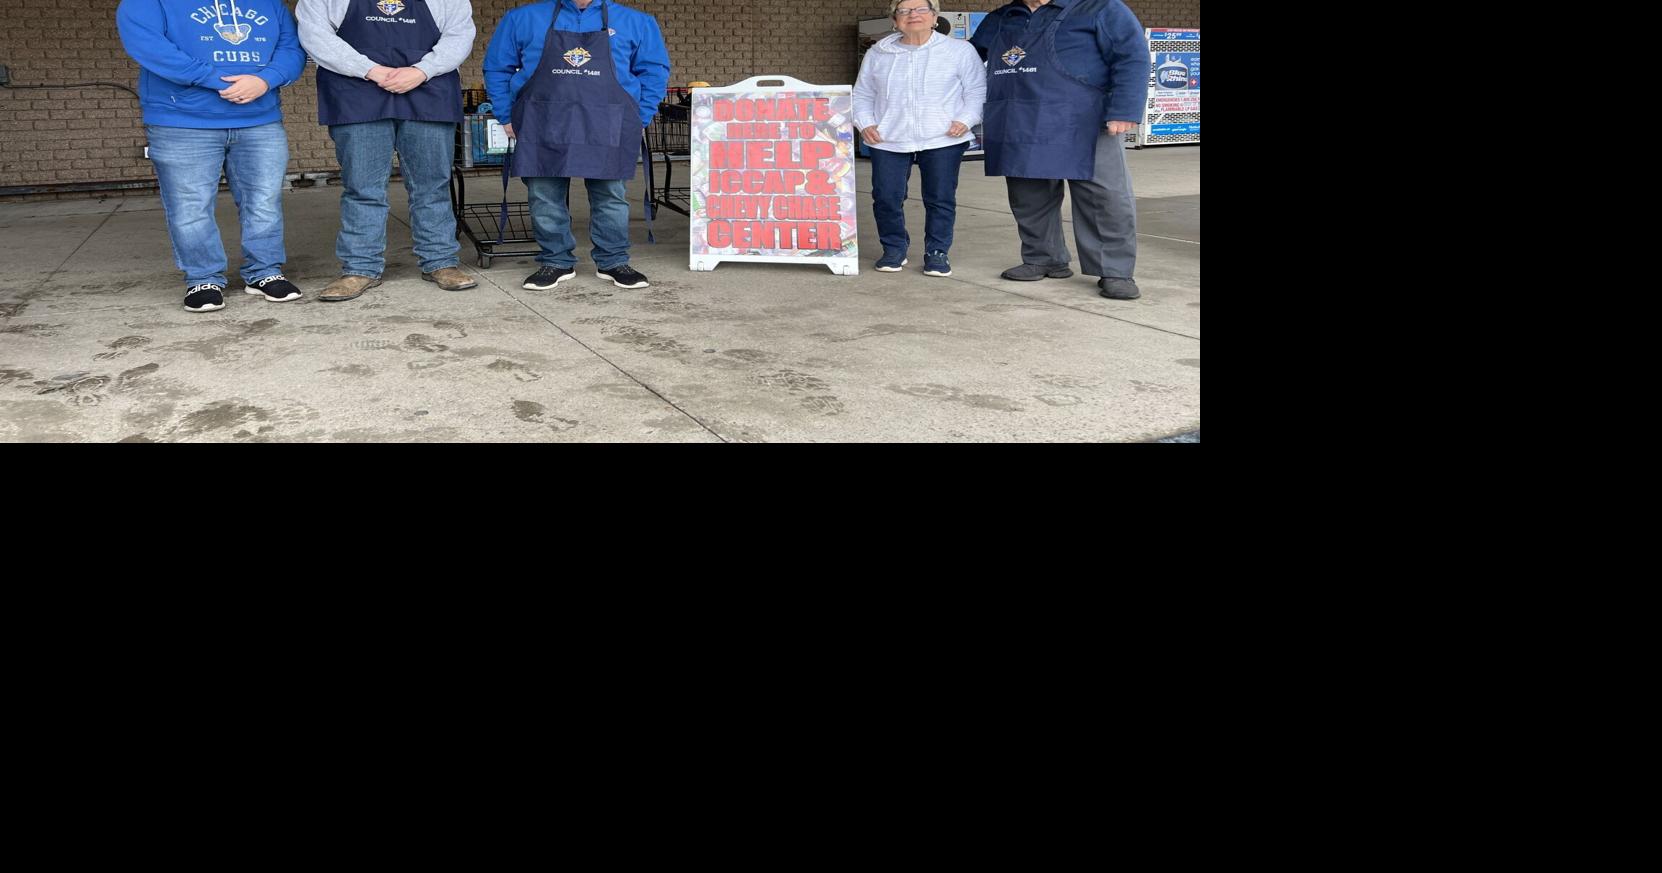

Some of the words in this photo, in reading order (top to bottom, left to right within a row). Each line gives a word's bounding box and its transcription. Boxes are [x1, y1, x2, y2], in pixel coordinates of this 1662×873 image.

[190, 3, 269, 26] CHICAGO
[213, 50, 260, 62] CUBS
[712, 97, 831, 122] DONATE
[726, 122, 782, 139] HERE
[786, 122, 816, 139] TO
[709, 140, 836, 170] HELP
[706, 194, 772, 219] CHEVY
[772, 195, 842, 221] CHASE
[707, 219, 843, 250] CENTER
[186, 283, 222, 297] adida
